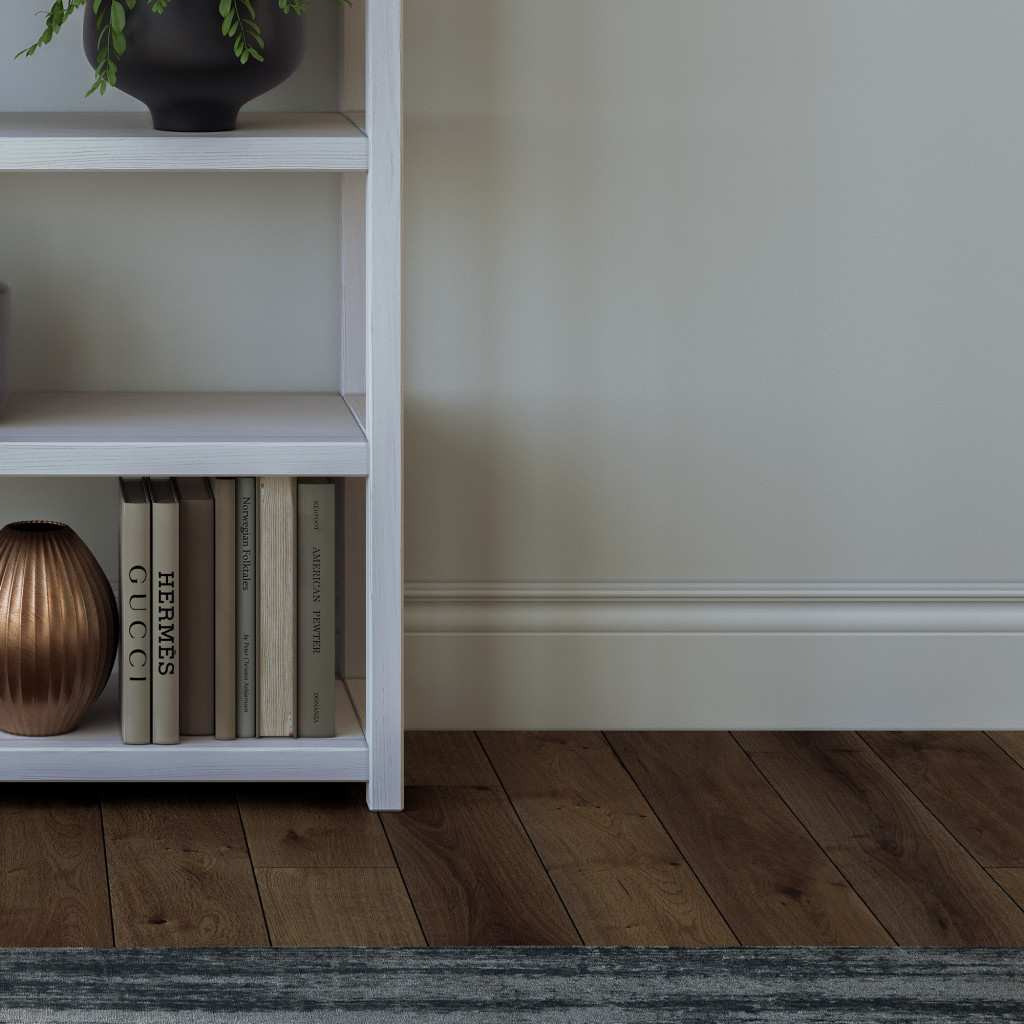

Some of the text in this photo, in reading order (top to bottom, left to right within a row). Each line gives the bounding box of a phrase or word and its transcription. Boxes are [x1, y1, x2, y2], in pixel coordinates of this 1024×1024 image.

[240, 497, 251, 590] Norwegian Folktales
[129, 565, 147, 681] GUCCI
[158, 572, 176, 675] HERMÈS
[312, 547, 321, 654] AMERICAN PEWTER
